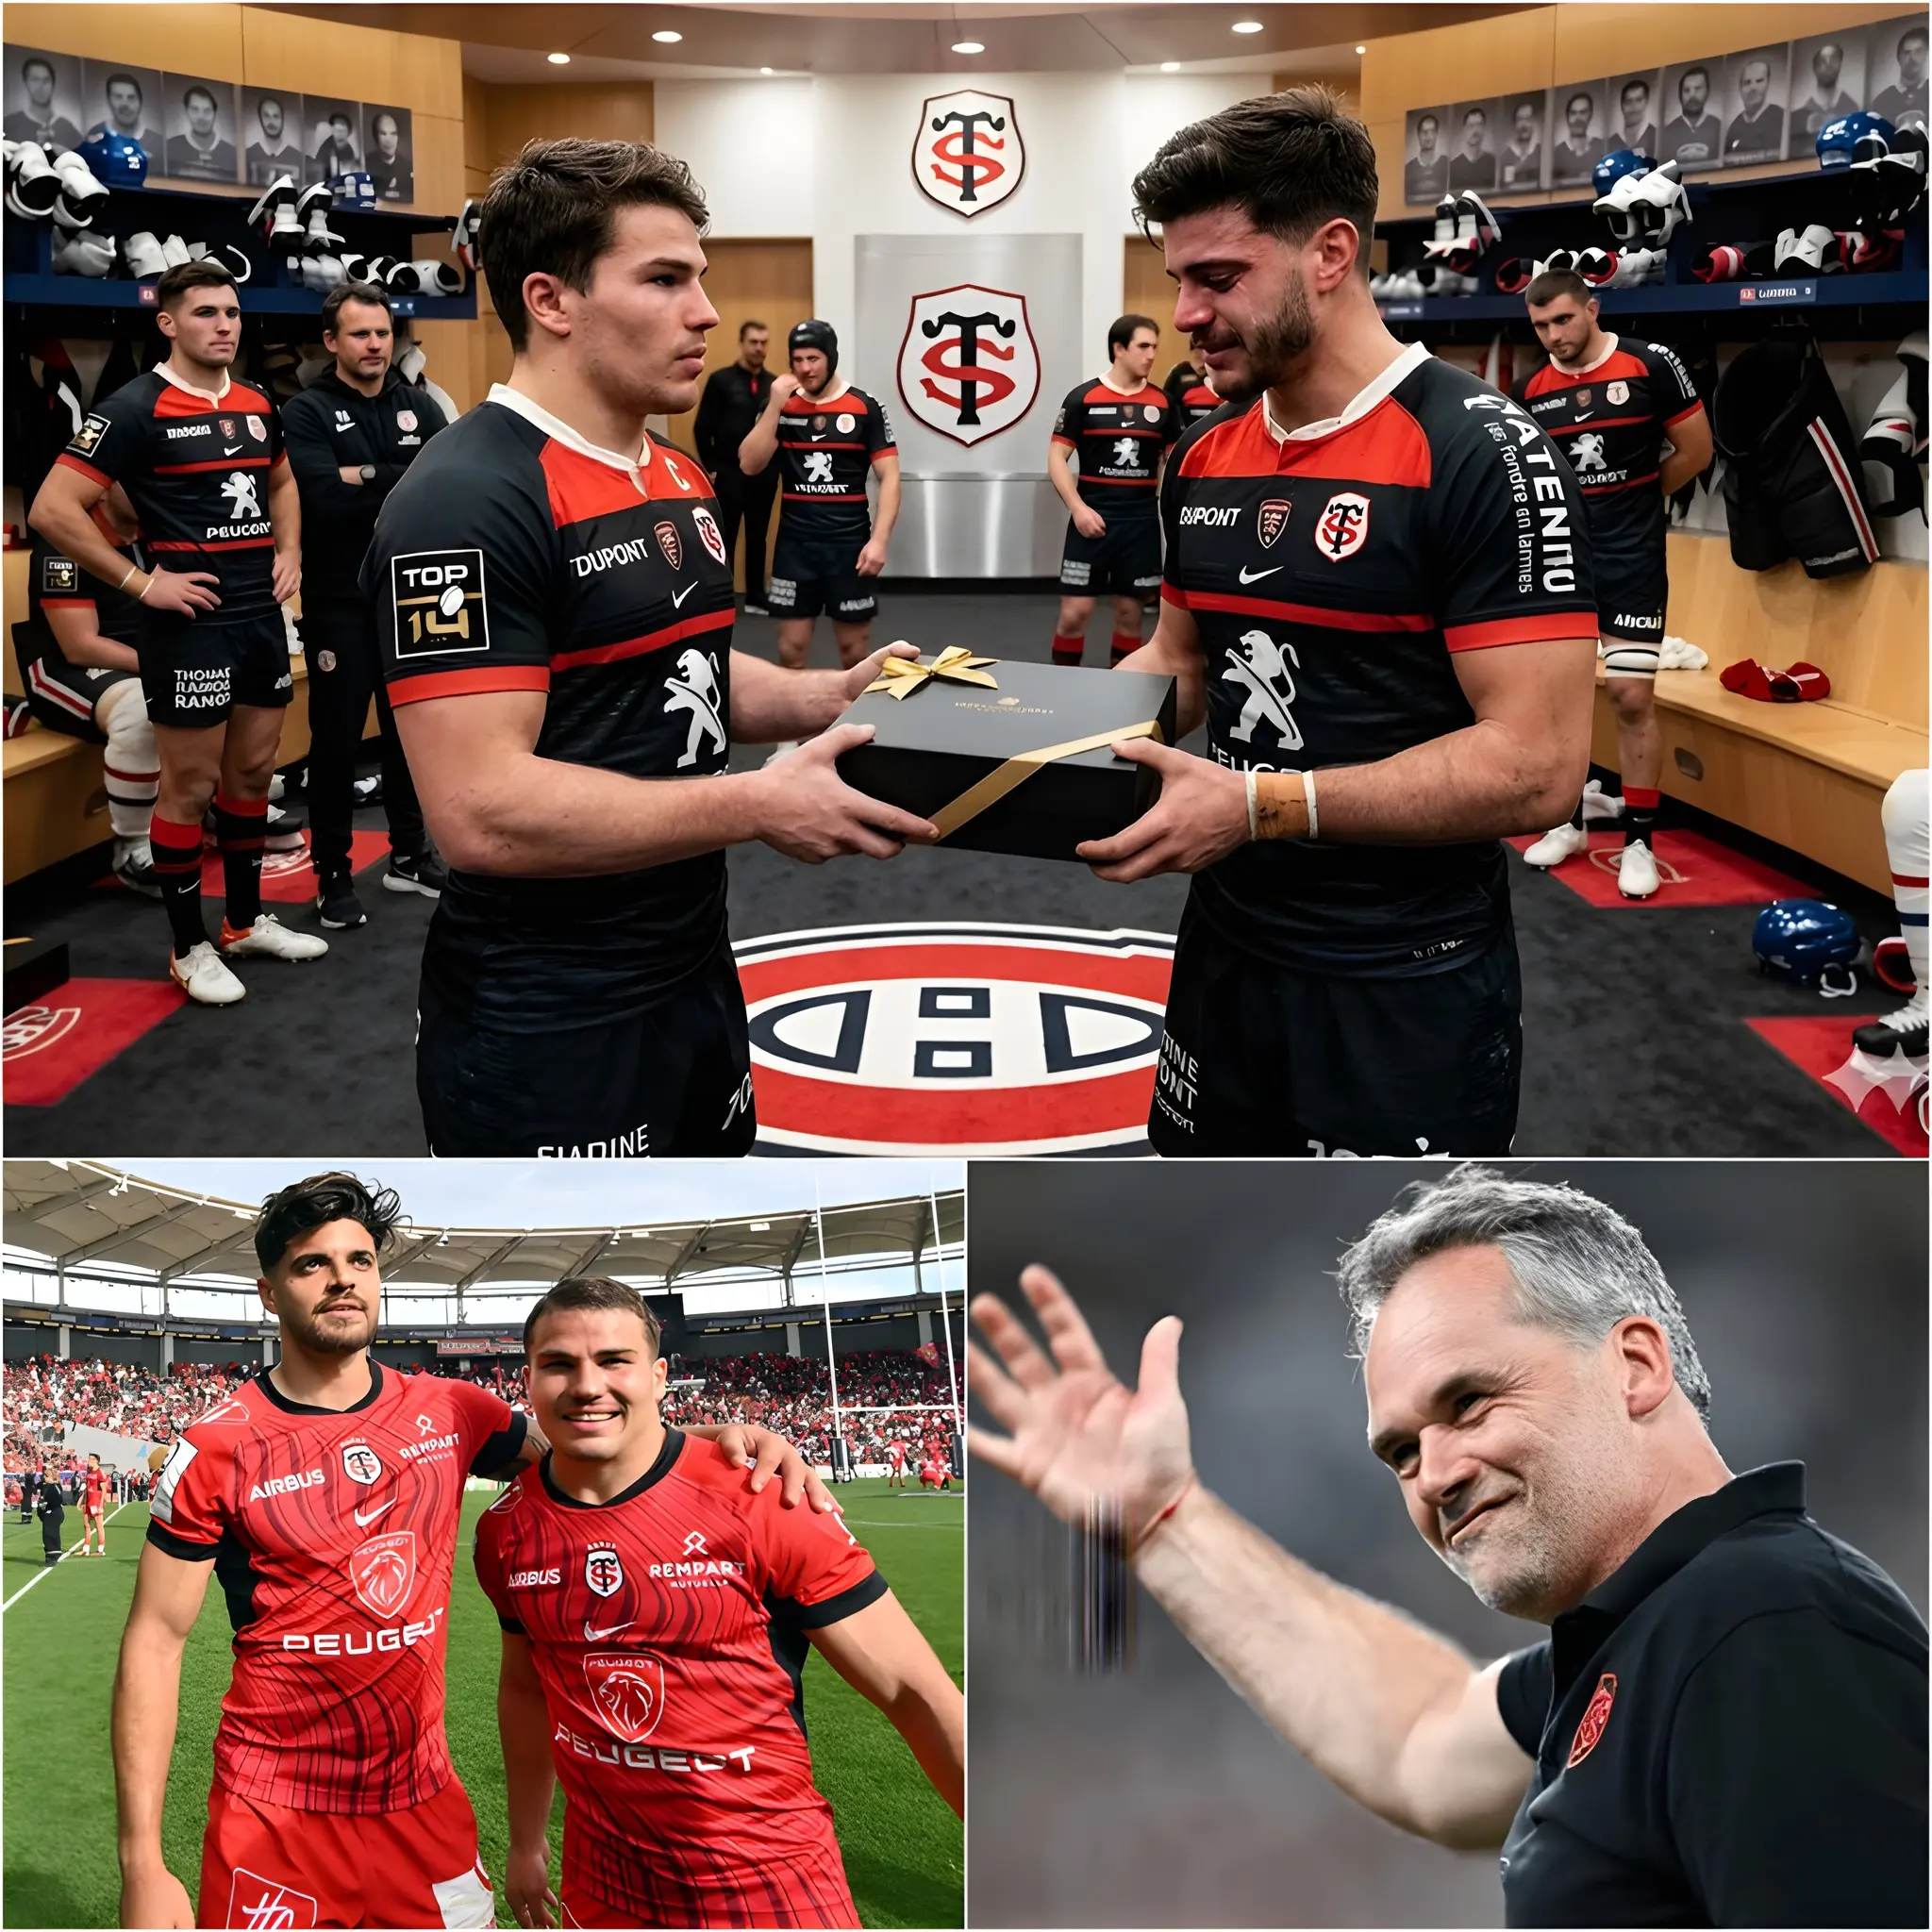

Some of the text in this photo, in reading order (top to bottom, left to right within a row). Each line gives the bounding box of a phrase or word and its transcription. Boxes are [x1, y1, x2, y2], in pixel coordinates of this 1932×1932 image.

[401, 564, 469, 589] TOP
[408, 608, 471, 643] 14
[249, 1469, 325, 1503] AIRBUS
[555, 1721, 757, 1774] PEUGEOT
